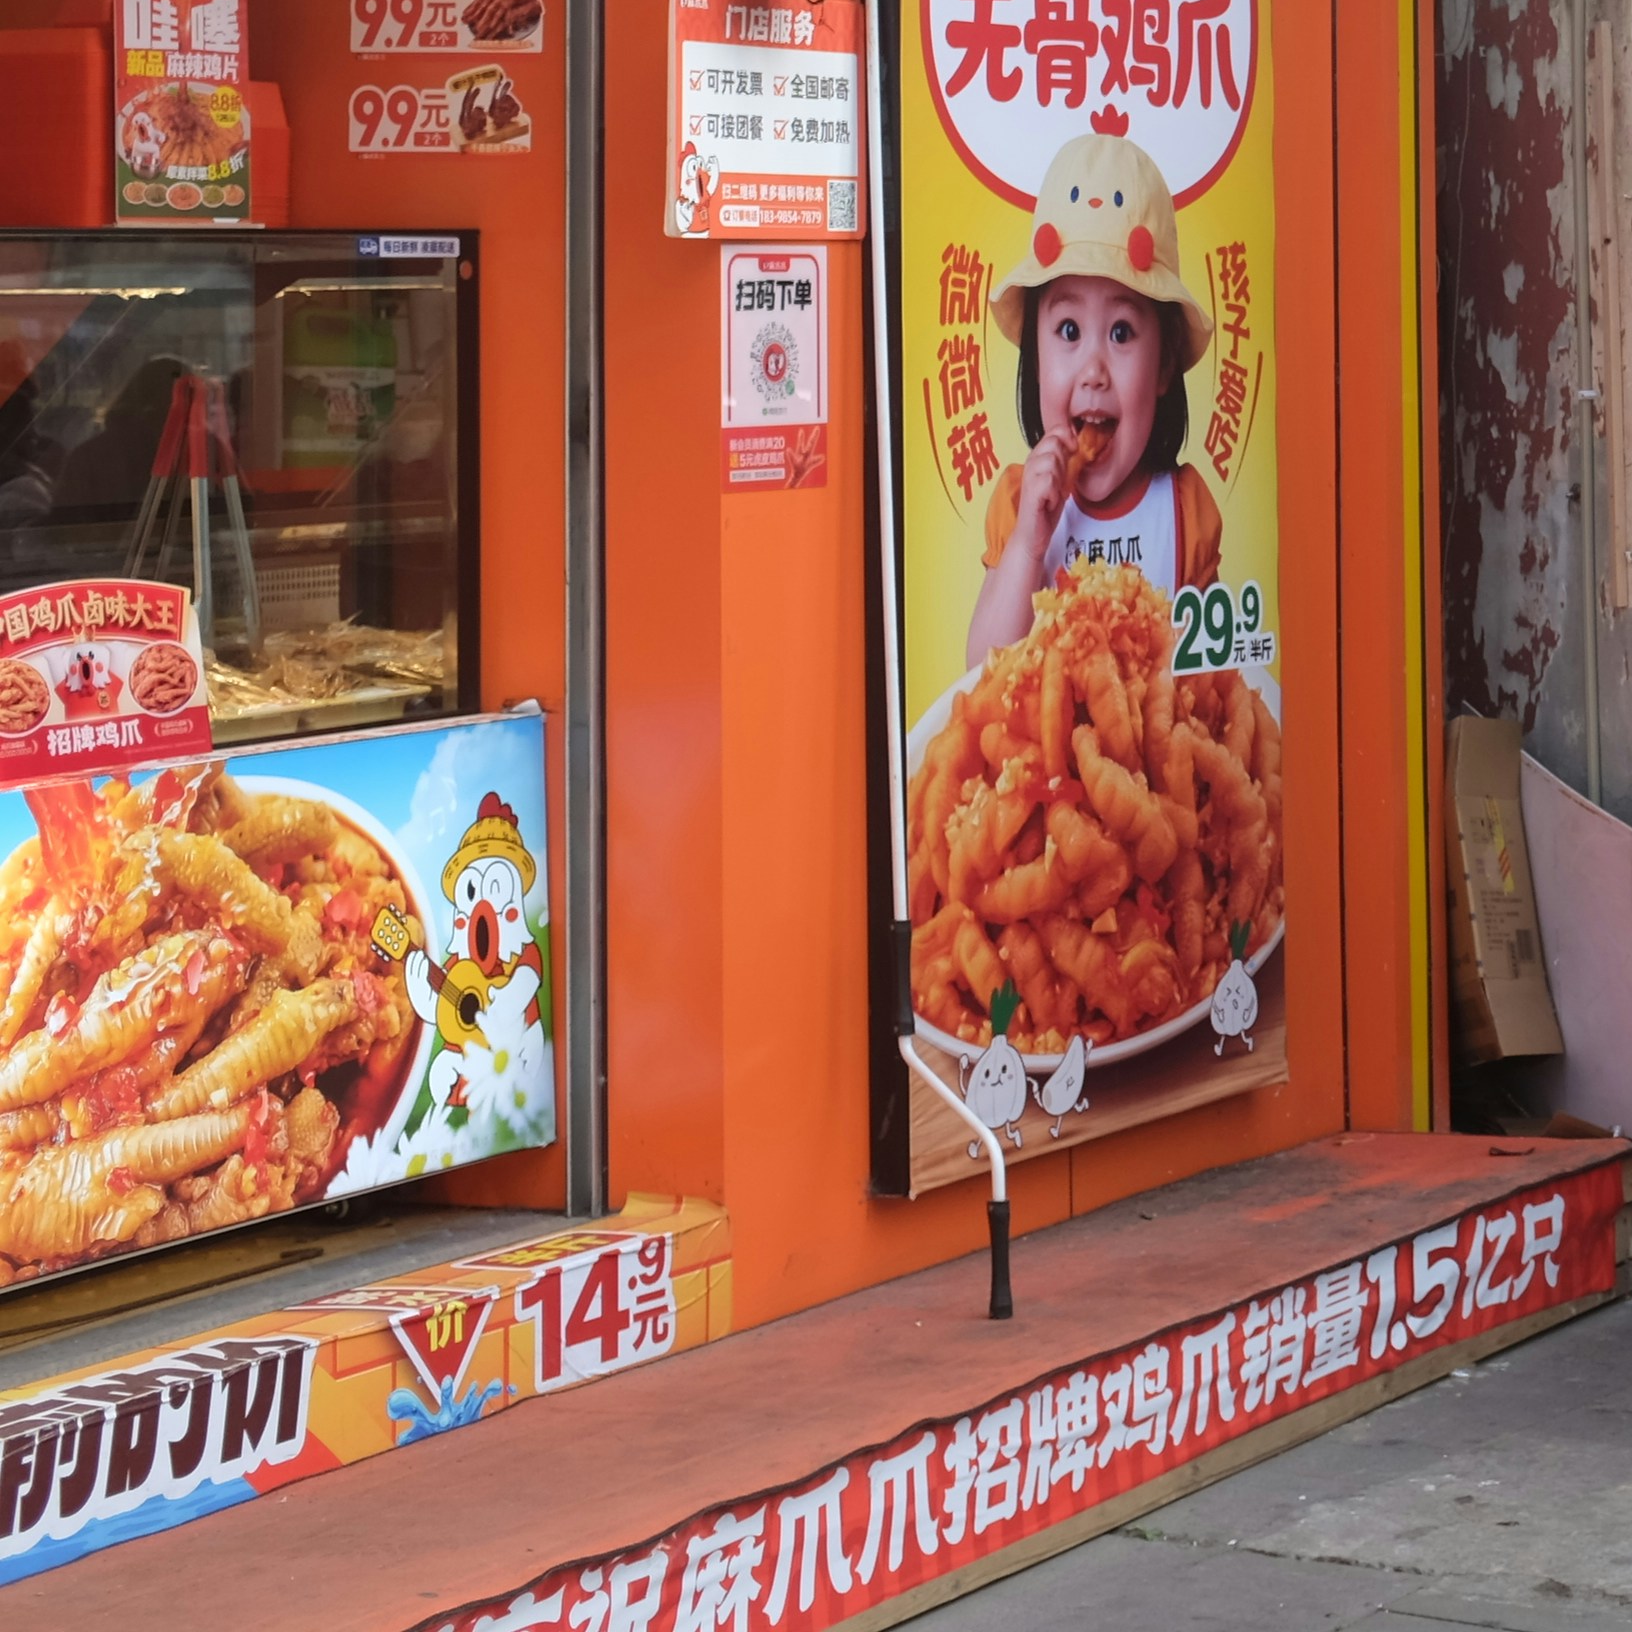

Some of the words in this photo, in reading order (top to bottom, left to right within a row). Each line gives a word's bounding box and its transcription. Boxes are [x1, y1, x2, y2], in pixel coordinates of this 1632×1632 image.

[725, 3, 816, 46] 门店服务
[706, 68, 764, 96] 可开发票
[790, 73, 850, 102] 全国邮寄
[706, 113, 764, 141] 可接团餐
[790, 117, 851, 145] 免费加热
[735, 278, 813, 312] 扫码下单
[937, 242, 1001, 503] 微微辣
[1203, 240, 1252, 484] 孩子爱吃
[0, 589, 178, 644] 国鸡爪卤味大王
[1172, 582, 1262, 672] 29.9
[46, 718, 144, 757] 招牌鸡爪
